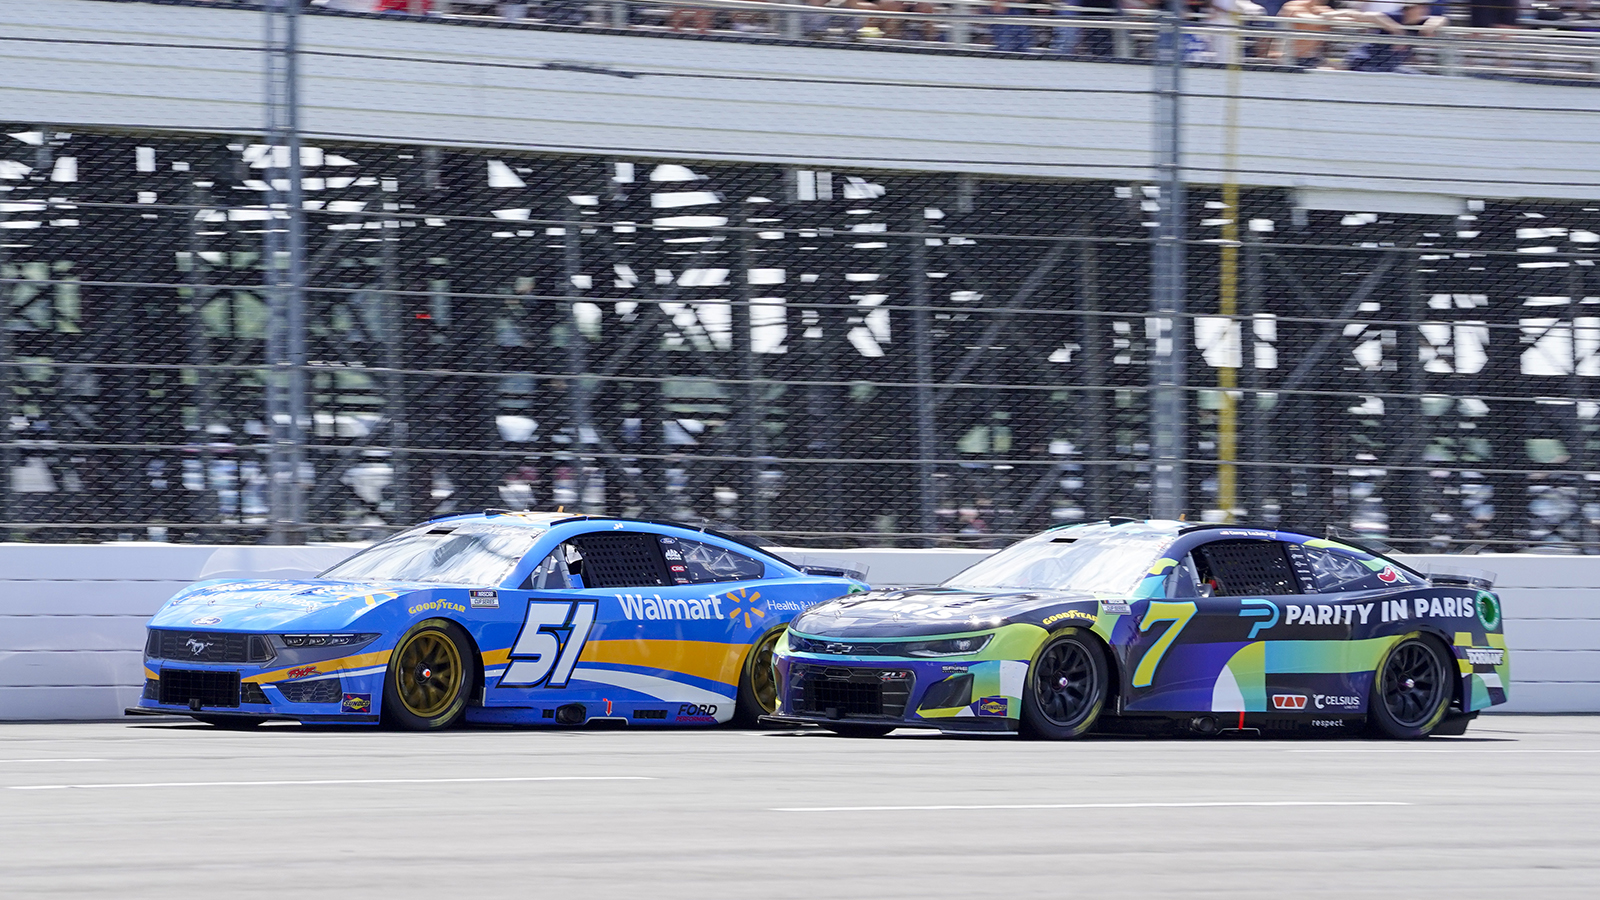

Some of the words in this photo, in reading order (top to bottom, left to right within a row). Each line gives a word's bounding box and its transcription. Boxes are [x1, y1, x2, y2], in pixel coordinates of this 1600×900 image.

[408, 599, 466, 614] GOODYEAR
[615, 594, 724, 620] Walmart
[767, 600, 800, 611] Health
[1285, 605, 1374, 625] PARITY
[1381, 599, 1409, 622] IN
[1414, 597, 1475, 618] PARIS
[1042, 610, 1098, 624] GOODYEAR
[497, 599, 598, 688] 51
[1132, 601, 1198, 687] 7
[678, 704, 718, 716] FORD
[980, 703, 1007, 711] SUNOCO
